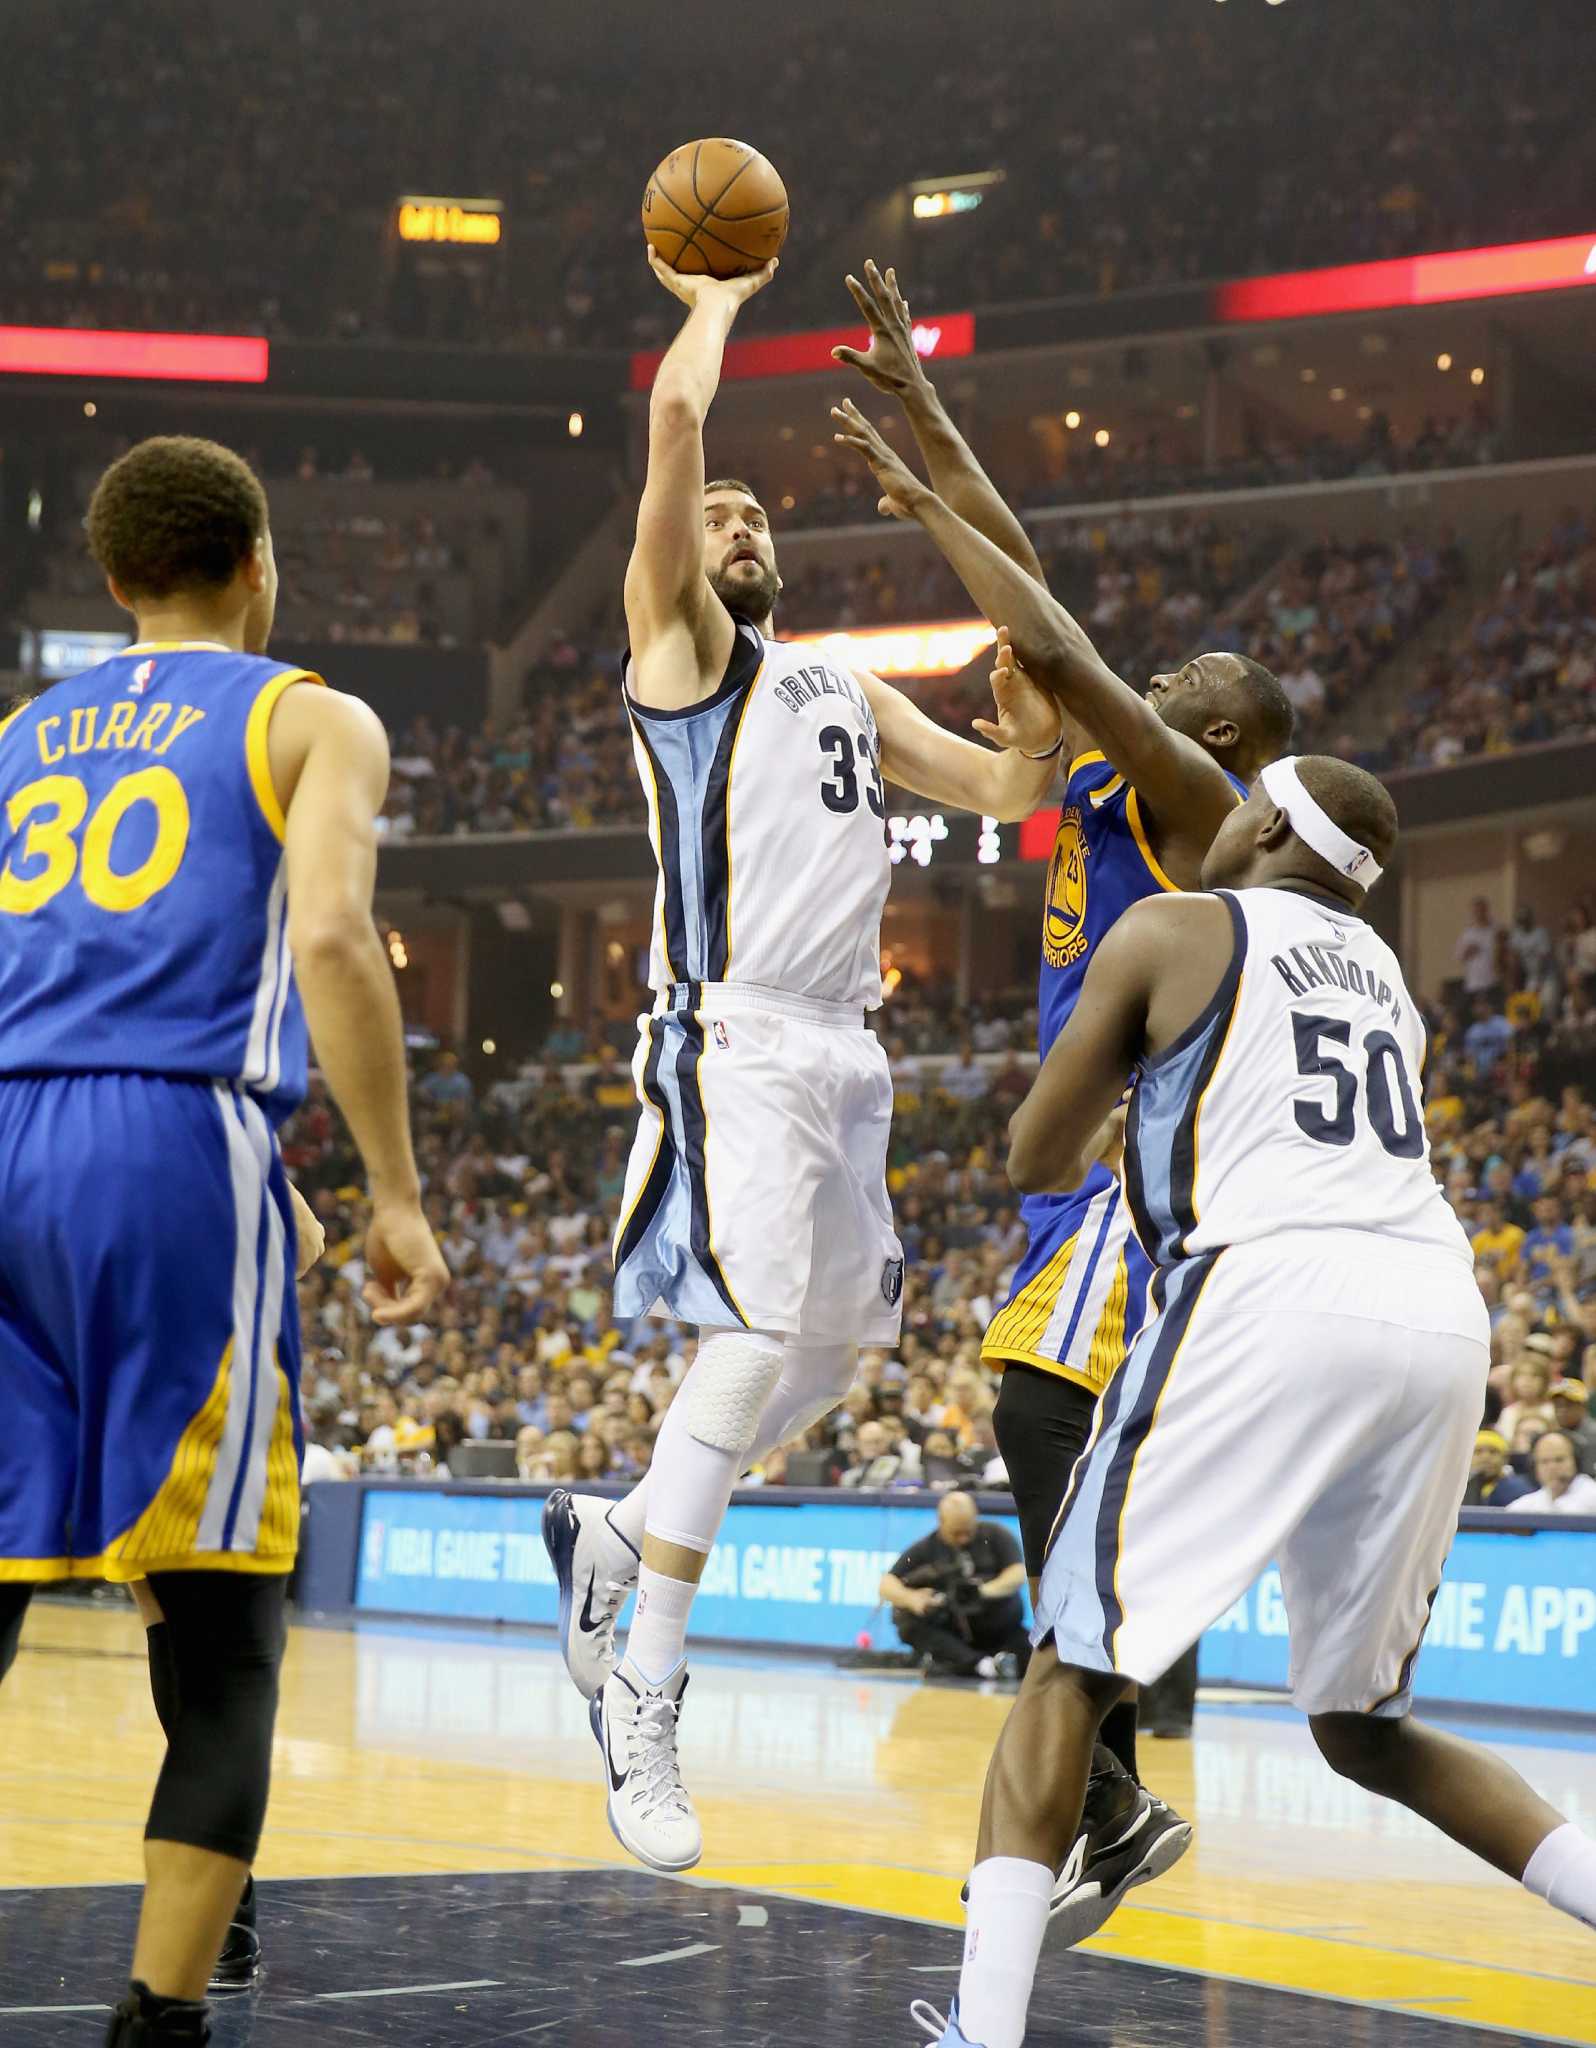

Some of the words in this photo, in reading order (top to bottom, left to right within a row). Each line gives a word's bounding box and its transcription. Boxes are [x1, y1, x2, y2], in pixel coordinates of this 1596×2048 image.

[37, 700, 206, 764] CURRY
[0, 765, 190, 915] 30
[1043, 932, 1089, 968] RRIORS
[1271, 944, 1401, 1027] RANDOLPH
[1290, 1010, 1424, 1160] 50
[503, 1532, 559, 1585] TIM
[741, 1543, 824, 1605] GAME
[1422, 1580, 1487, 1650] ME
[1492, 1583, 1596, 1659] APP
